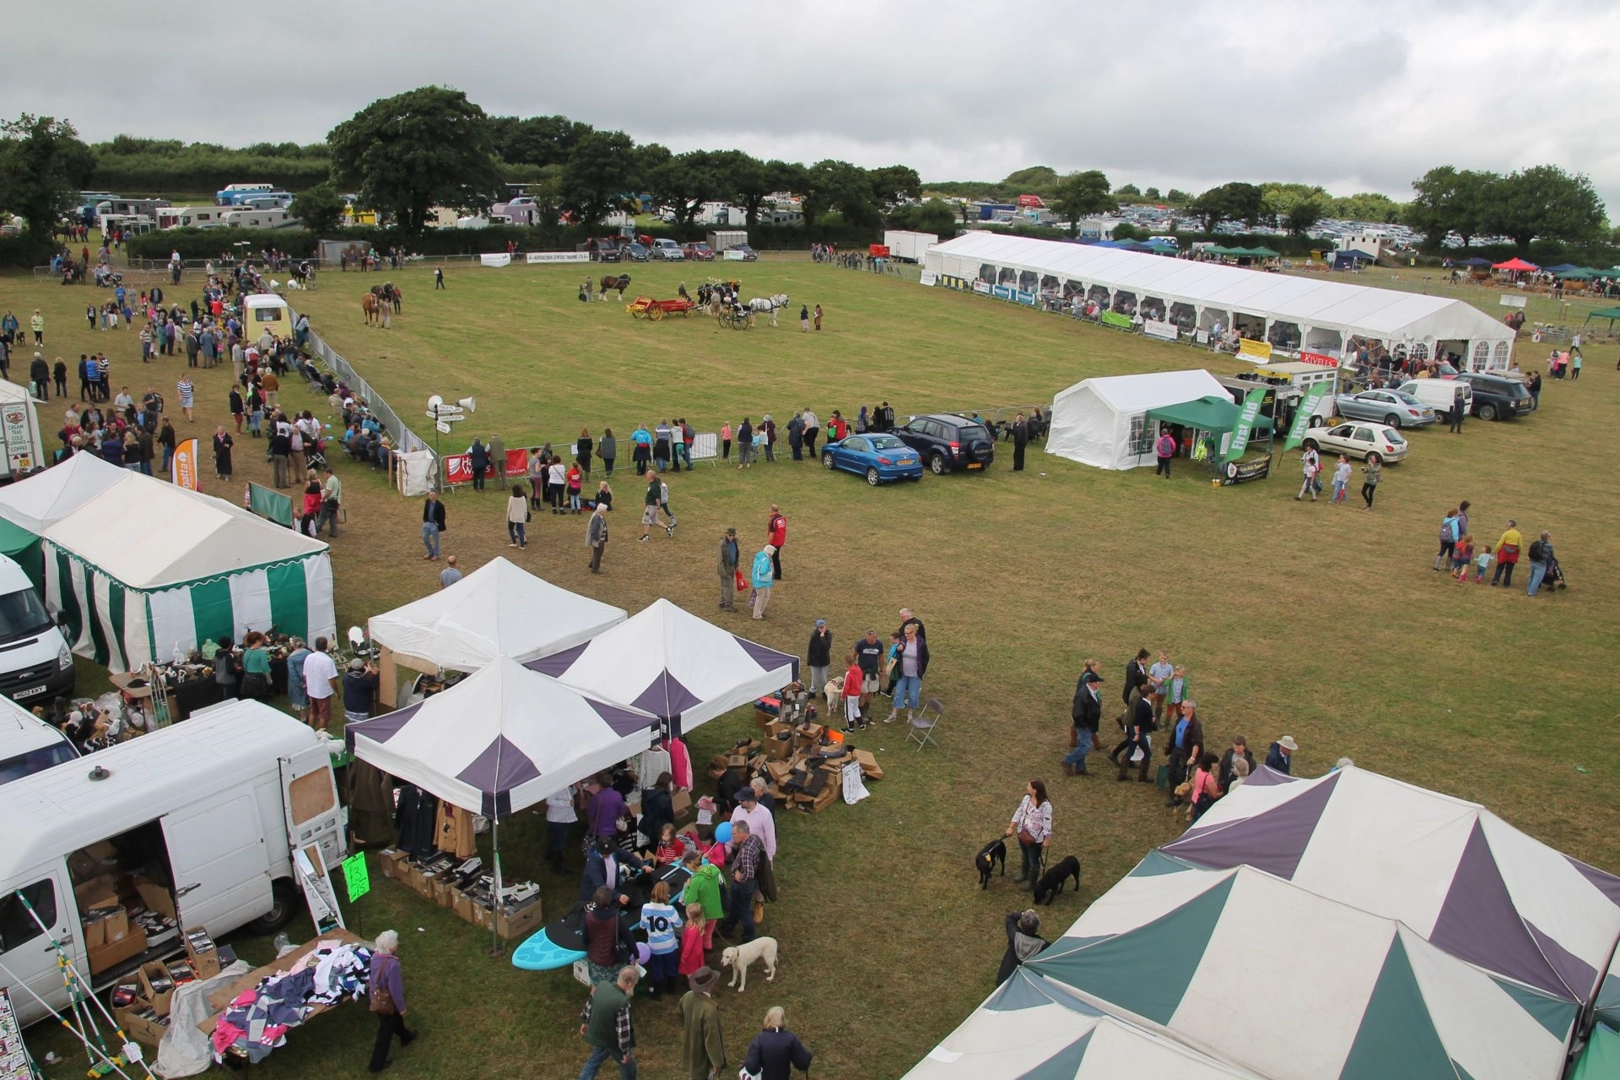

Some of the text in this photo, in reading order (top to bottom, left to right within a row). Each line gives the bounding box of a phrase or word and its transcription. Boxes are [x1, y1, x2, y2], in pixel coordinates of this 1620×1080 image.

[1304, 354, 1333, 367] KIVELLS
[1230, 402, 1258, 450] First Aid
[1290, 395, 1320, 440] First Aid
[646, 916, 668, 932] 10
